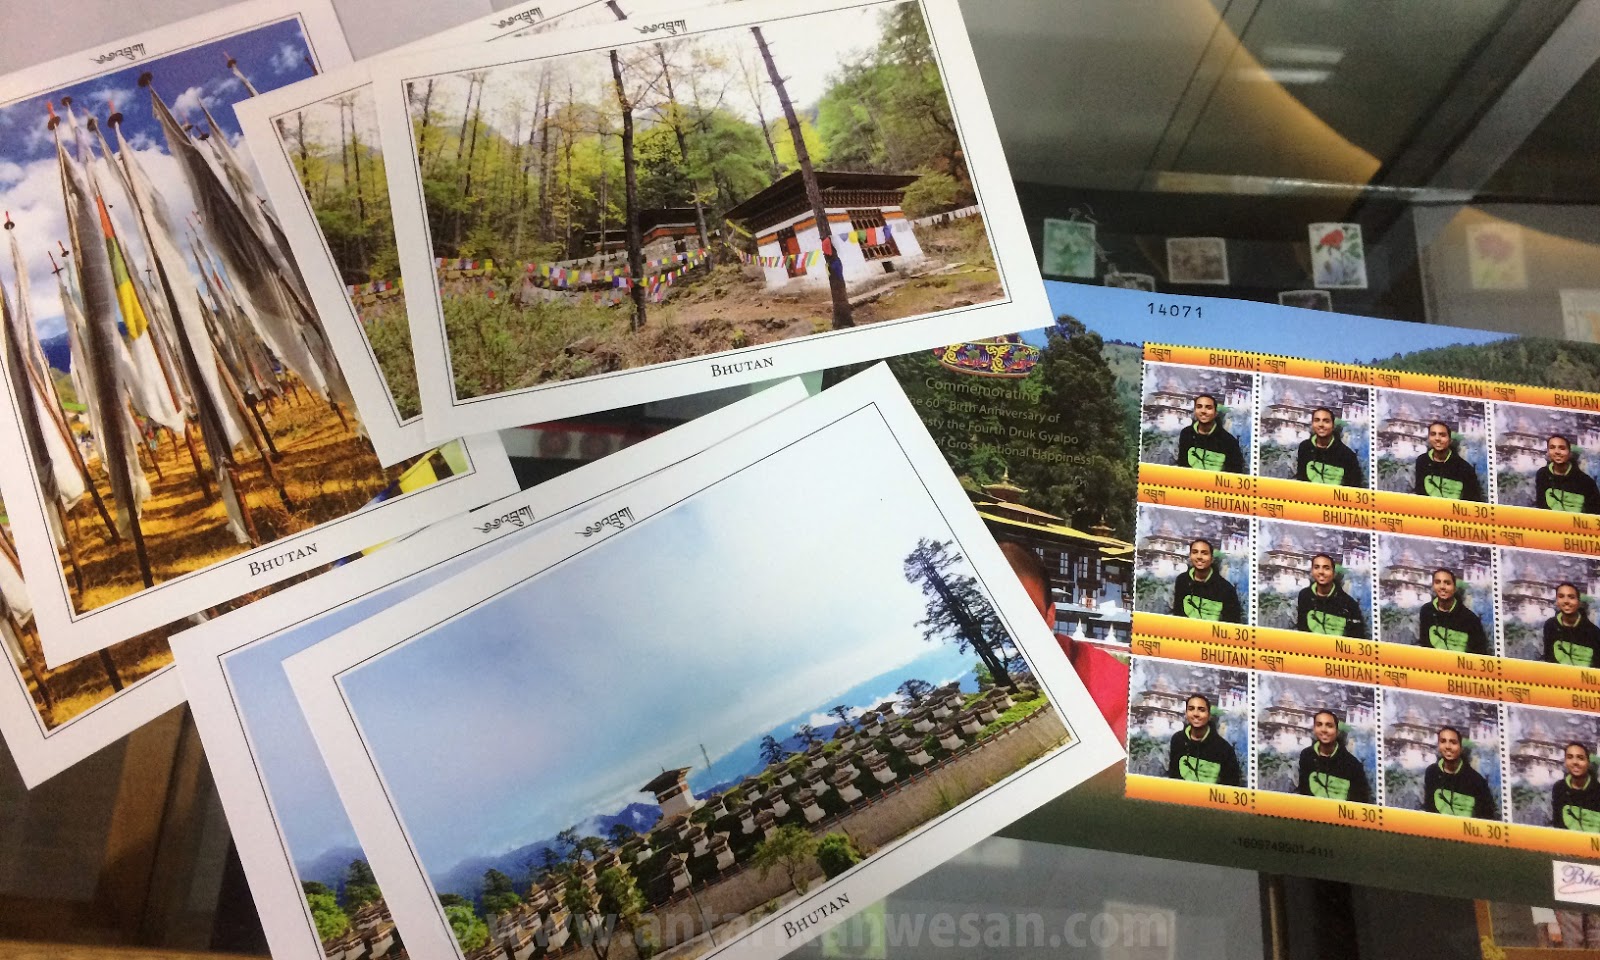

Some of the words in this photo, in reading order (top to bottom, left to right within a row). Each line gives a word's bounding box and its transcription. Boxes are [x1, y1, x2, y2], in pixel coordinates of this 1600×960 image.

[1148, 302, 1202, 318] 14071
[711, 357, 774, 377] BHUTAN
[1209, 353, 1254, 369] BHUTAN
[1323, 366, 1368, 383] BHUTAN
[925, 377, 1040, 404] Commemorating
[1438, 380, 1483, 396] BHUTAN
[1554, 393, 1599, 409] BHUTAN
[950, 400, 976, 413] Birth
[979, 405, 1046, 423] Anniversary
[1047, 414, 1061, 423] of
[947, 420, 966, 430] the
[968, 421, 1006, 435] Fourth
[1008, 426, 1036, 439] Druk
[1039, 431, 1079, 444] Gyalpo
[947, 438, 979, 450] Gross
[981, 442, 1029, 457] National
[1032, 448, 1095, 465] Happiness)
[1215, 475, 1234, 489] Nu.
[1237, 478, 1250, 491] 30
[1204, 496, 1250, 513] BHUTAN
[1333, 489, 1352, 503] Nu.
[1355, 492, 1369, 505] 30
[1323, 510, 1369, 527] BHUTAN
[1452, 503, 1471, 517] Nu.
[1474, 506, 1488, 519] 30
[1573, 516, 1591, 530] Nu.
[1442, 525, 1489, 542] BHUTAN
[248, 542, 318, 577] BHUTAN
[1212, 625, 1231, 639] Nu.
[1234, 628, 1249, 641] 30
[1201, 648, 1249, 666] BHUTAN
[1335, 640, 1355, 655] Nu.
[1358, 643, 1372, 657] 30
[1325, 663, 1373, 681] BHUTAN
[1457, 655, 1477, 671] Nu.
[1480, 659, 1494, 673] 30
[1581, 671, 1600, 686] Nu.
[1447, 680, 1495, 698] BHUTAN
[1209, 788, 1228, 804] Nu.
[1233, 791, 1248, 806] 30
[1338, 804, 1357, 820] Nu.
[1362, 808, 1376, 823] 30
[1463, 822, 1482, 838] Nu.
[1487, 824, 1502, 840] 30
[782, 892, 850, 939] BHUTAN
